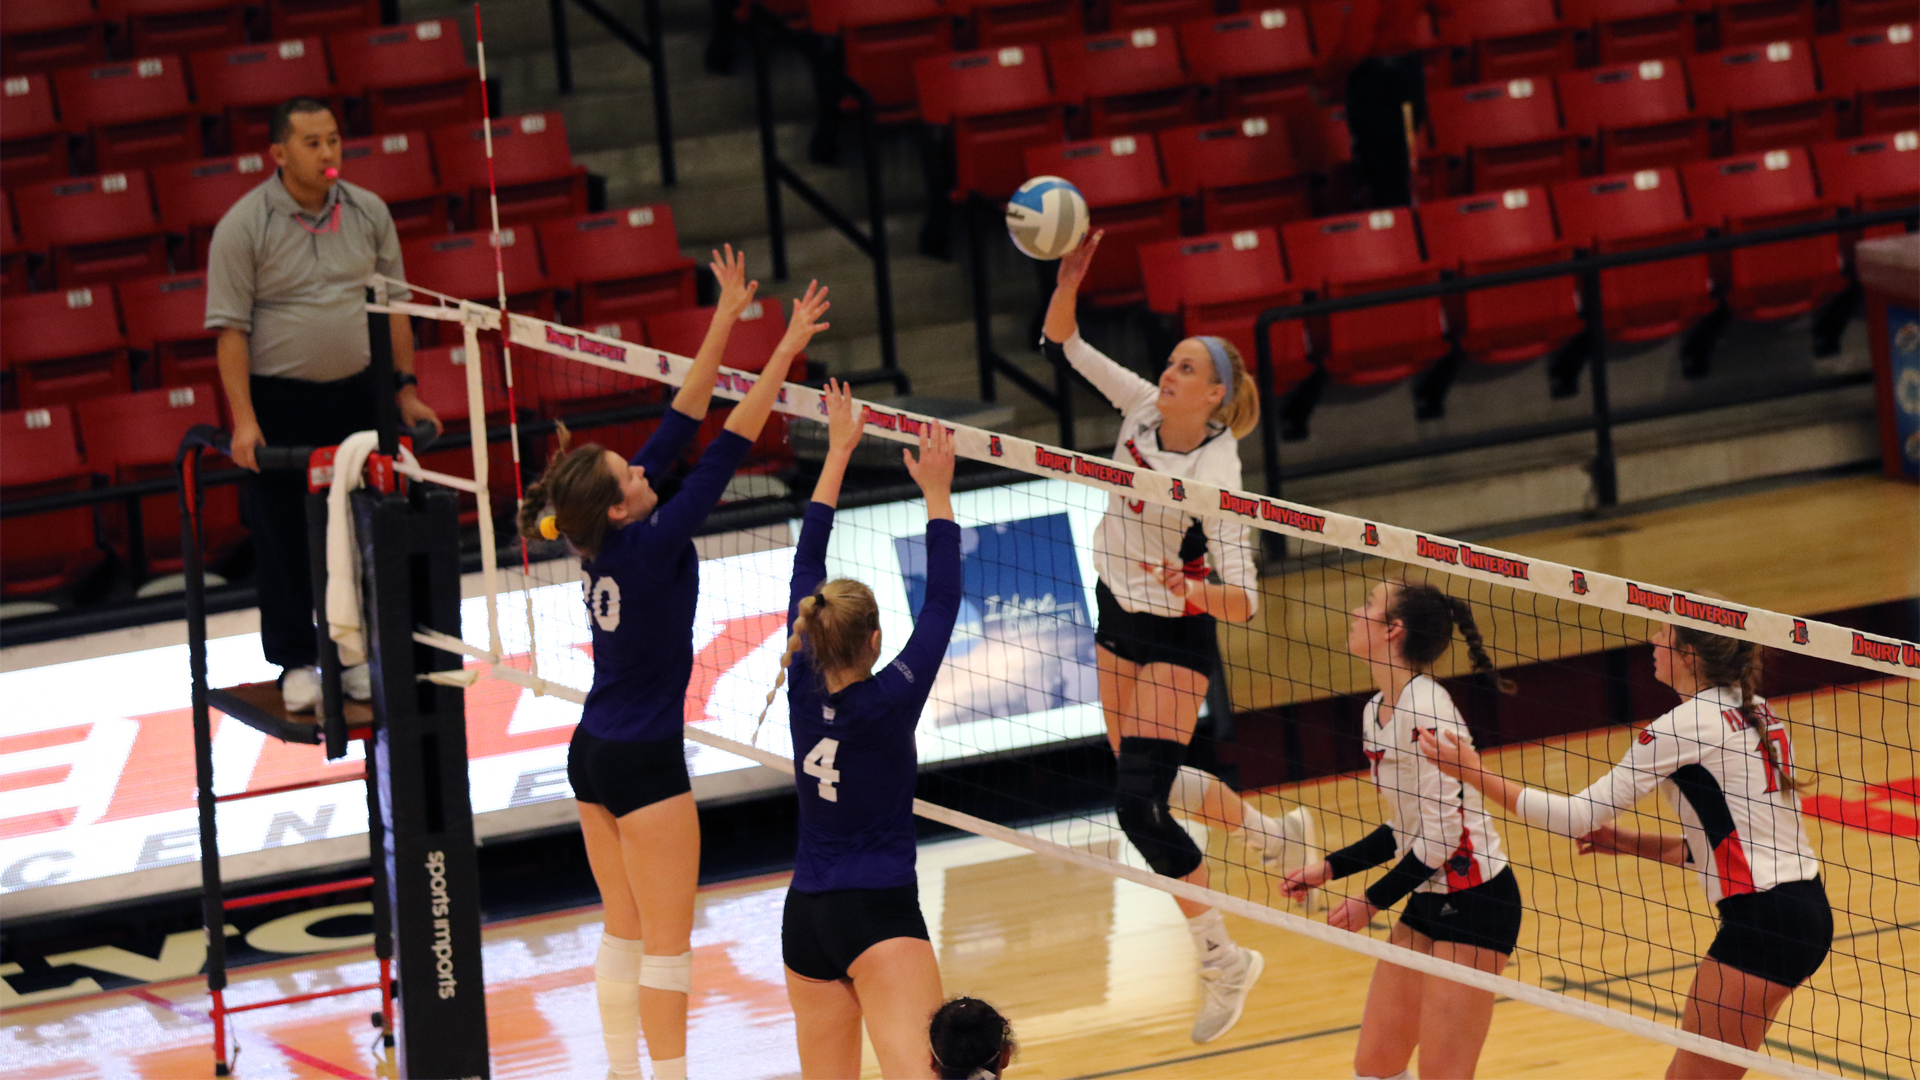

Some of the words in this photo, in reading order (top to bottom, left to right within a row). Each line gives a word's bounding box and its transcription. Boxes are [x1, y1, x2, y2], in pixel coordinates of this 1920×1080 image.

[1035, 446, 1073, 474] DRURY
[1072, 454, 1135, 488] UNIVERSITY
[1219, 489, 1260, 519] DRURY
[1259, 498, 1326, 535] UNIVERSITY
[1416, 534, 1459, 565] DRURY
[1458, 544, 1530, 581] UNIVERSITY
[1626, 582, 1673, 615] DRURY
[1672, 592, 1749, 631] UNIVERSITY
[1851, 631, 1901, 666] DRURY
[803, 737, 840, 803] 4
[425, 850, 451, 918] sports
[431, 918, 457, 1000] imports
